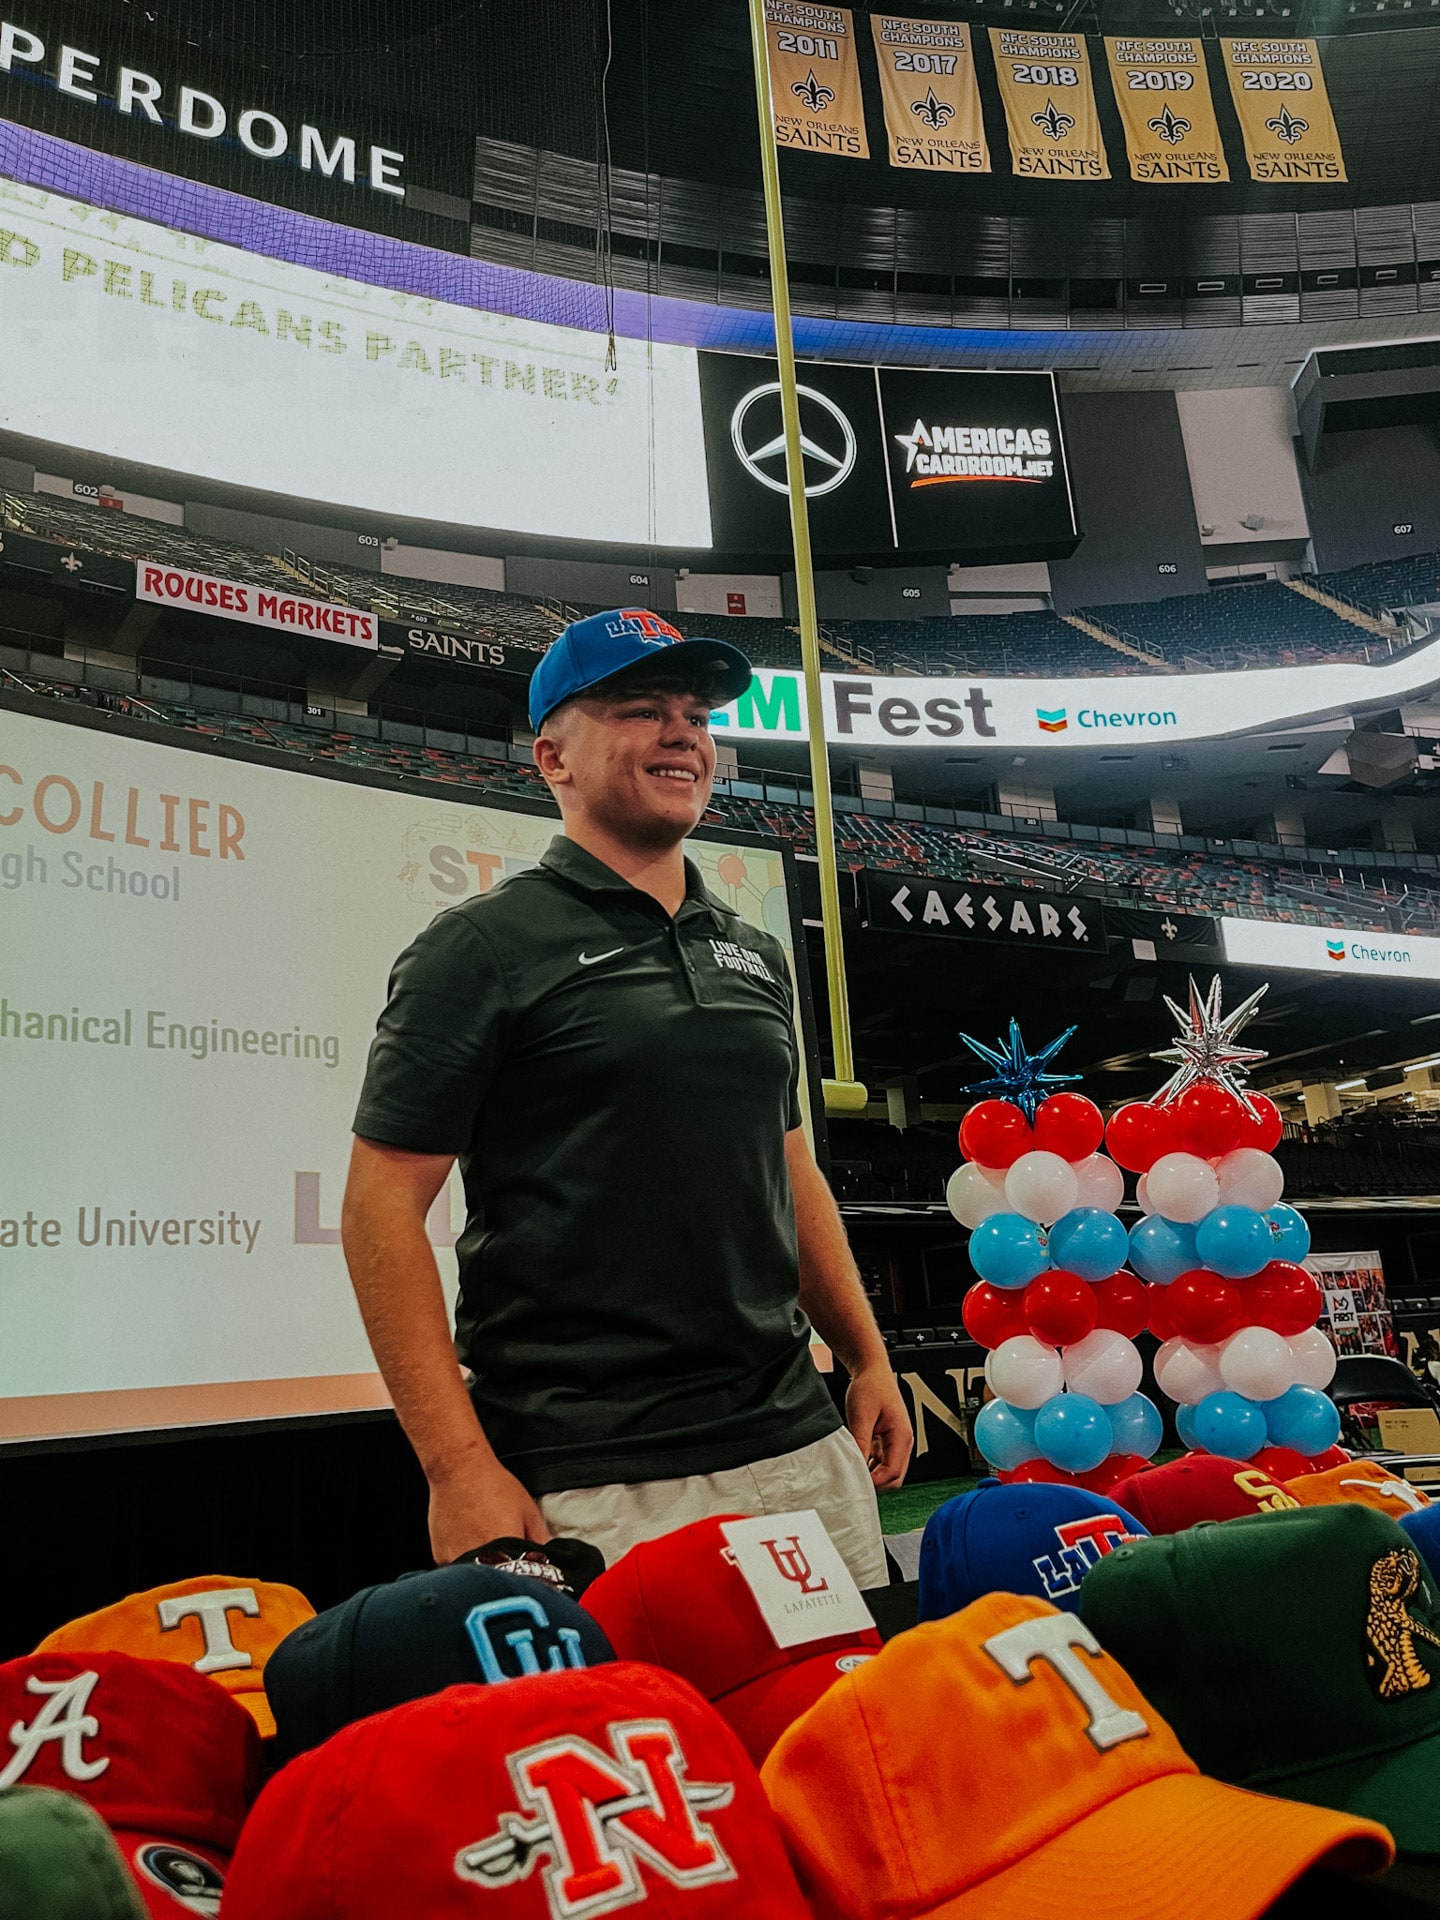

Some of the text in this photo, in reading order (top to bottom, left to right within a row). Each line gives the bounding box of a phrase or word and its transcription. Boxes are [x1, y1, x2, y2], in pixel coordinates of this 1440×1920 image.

[766, 0, 842, 21] NFC SOUTH
[766, 11, 846, 33] CHAMPIONS
[882, 19, 959, 36] NFC SOUTH
[777, 31, 838, 60] 2011
[881, 31, 964, 48] CHAMPIONS
[1000, 33, 1075, 47] NFC SOUTH
[1116, 41, 1192, 51] NFC SOUTH
[1231, 42, 1307, 52] NFC SOUTH
[1000, 44, 1080, 59] CHAMPIONS
[1115, 52, 1197, 63] CHAMPIONS
[1232, 53, 1312, 64] CHAMPIONS
[894, 51, 957, 75] 2017
[1012, 63, 1078, 86] 2018
[1127, 70, 1194, 90] 2019
[1241, 71, 1312, 91] 2020
[0, 21, 405, 197] PERDOME
[775, 114, 859, 134] NEW ORLEANS
[776, 126, 861, 153] SAINTS
[895, 136, 981, 150] NEW ORLEANS
[897, 146, 982, 168] SAINTS
[1019, 148, 1099, 159] NEW ORLEANS
[1135, 153, 1218, 162] NEW ORLEANS
[1253, 153, 1335, 161] NEW ORLEANS
[1019, 158, 1102, 178] SAINTS
[1137, 162, 1221, 178] SAINTS
[1256, 162, 1339, 178] SAINTS
[62, 247, 348, 355] PELICANS
[894, 418, 1052, 464] AMERICAS
[916, 454, 1054, 477] CARDROOM.NET
[74, 484, 98, 497] 602
[1394, 525, 1412, 533] 607
[358, 535, 379, 547] 603
[1159, 564, 1177, 573] 606
[630, 575, 648, 585] 604
[902, 588, 921, 597] 605
[144, 567, 373, 641] ROUSES MARKETS
[408, 629, 505, 666] SAINTS
[833, 680, 997, 737] Fest
[1077, 710, 1177, 728] Chevron
[60, 850, 180, 901] School
[709, 939, 742, 958] LIVE
[1351, 944, 1411, 963] Chevron
[713, 953, 775, 982] FOOTBALL
[1, 998, 341, 1069] hanical Engineering
[1, 1206, 262, 1254] ate University
[784, 1593, 842, 1614] LAFAYETTE
[158, 1587, 260, 1673] T
[982, 1611, 1150, 1754] T
